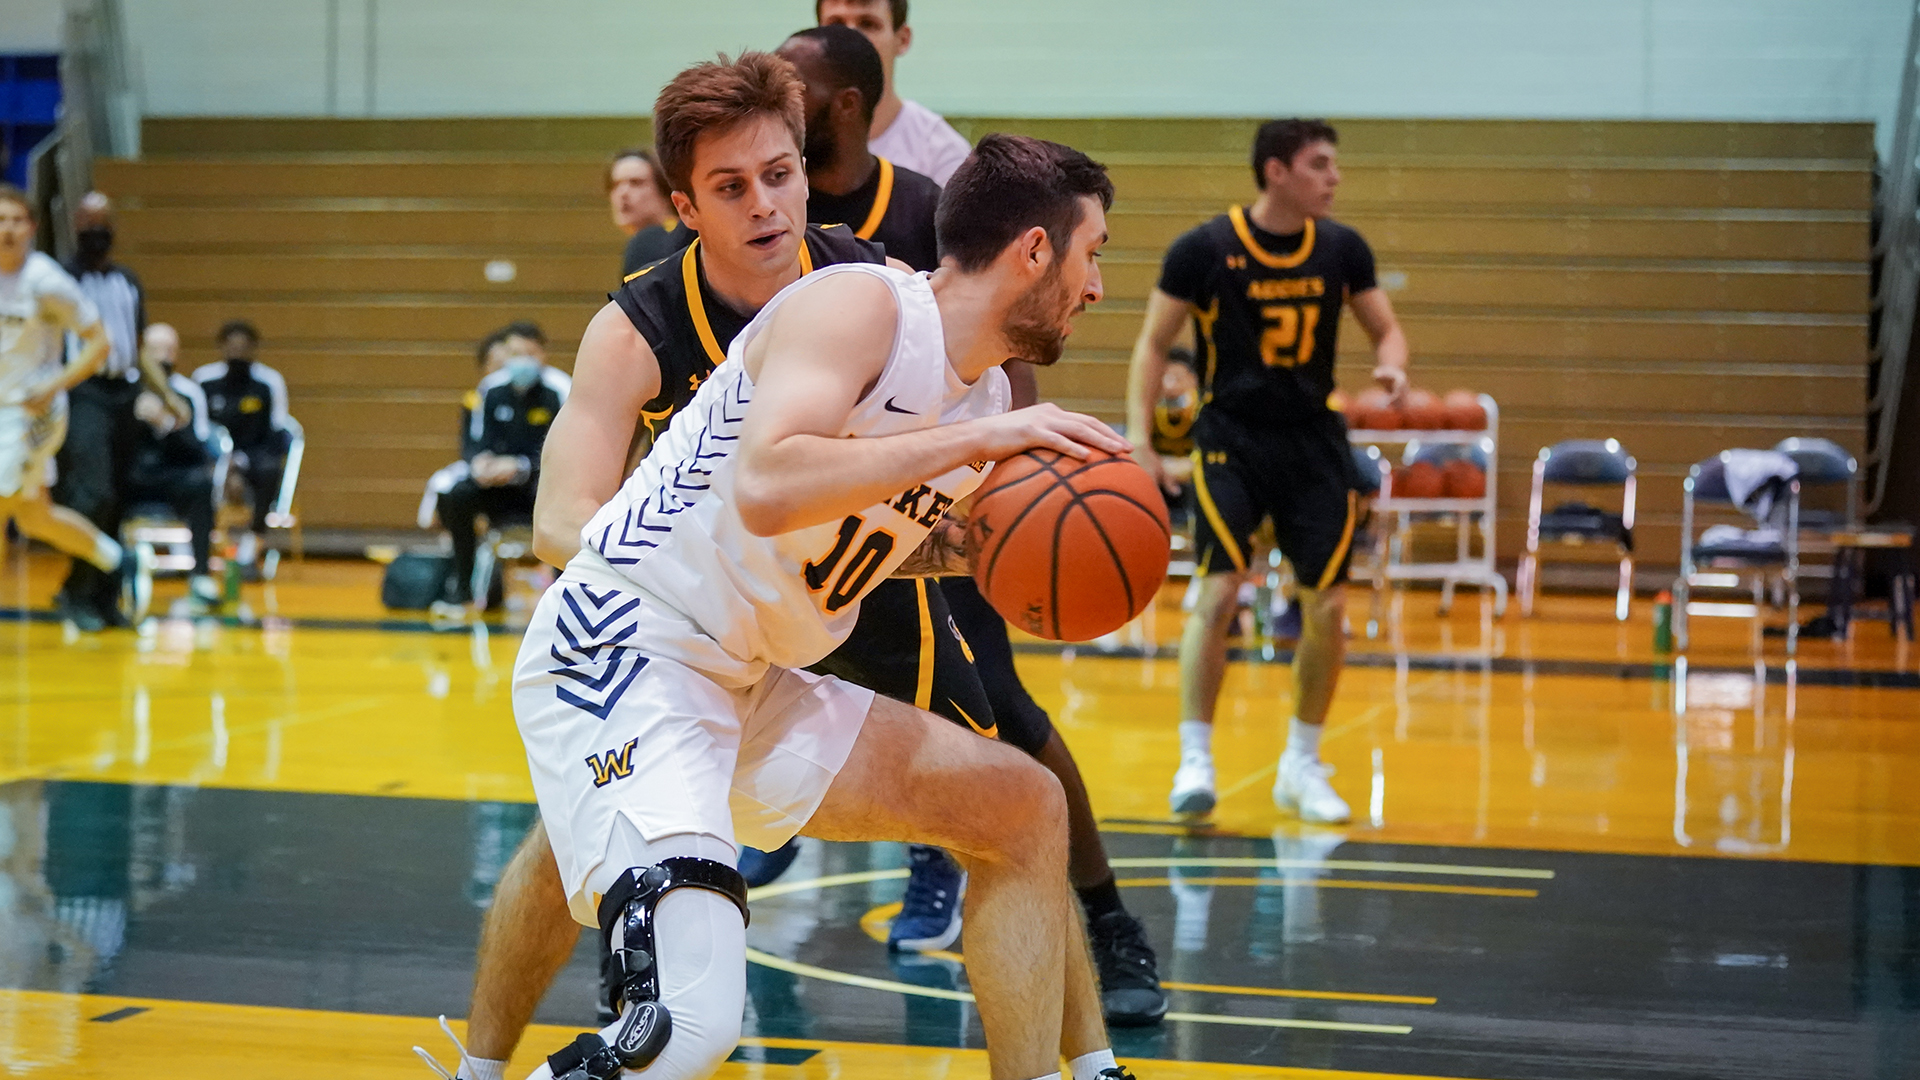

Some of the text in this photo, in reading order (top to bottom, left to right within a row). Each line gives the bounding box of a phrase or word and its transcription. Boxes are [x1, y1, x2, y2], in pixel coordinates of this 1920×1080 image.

[1260, 304, 1320, 367] 21
[883, 484, 954, 529] KE
[800, 512, 897, 615] 10
[585, 736, 639, 788] W
